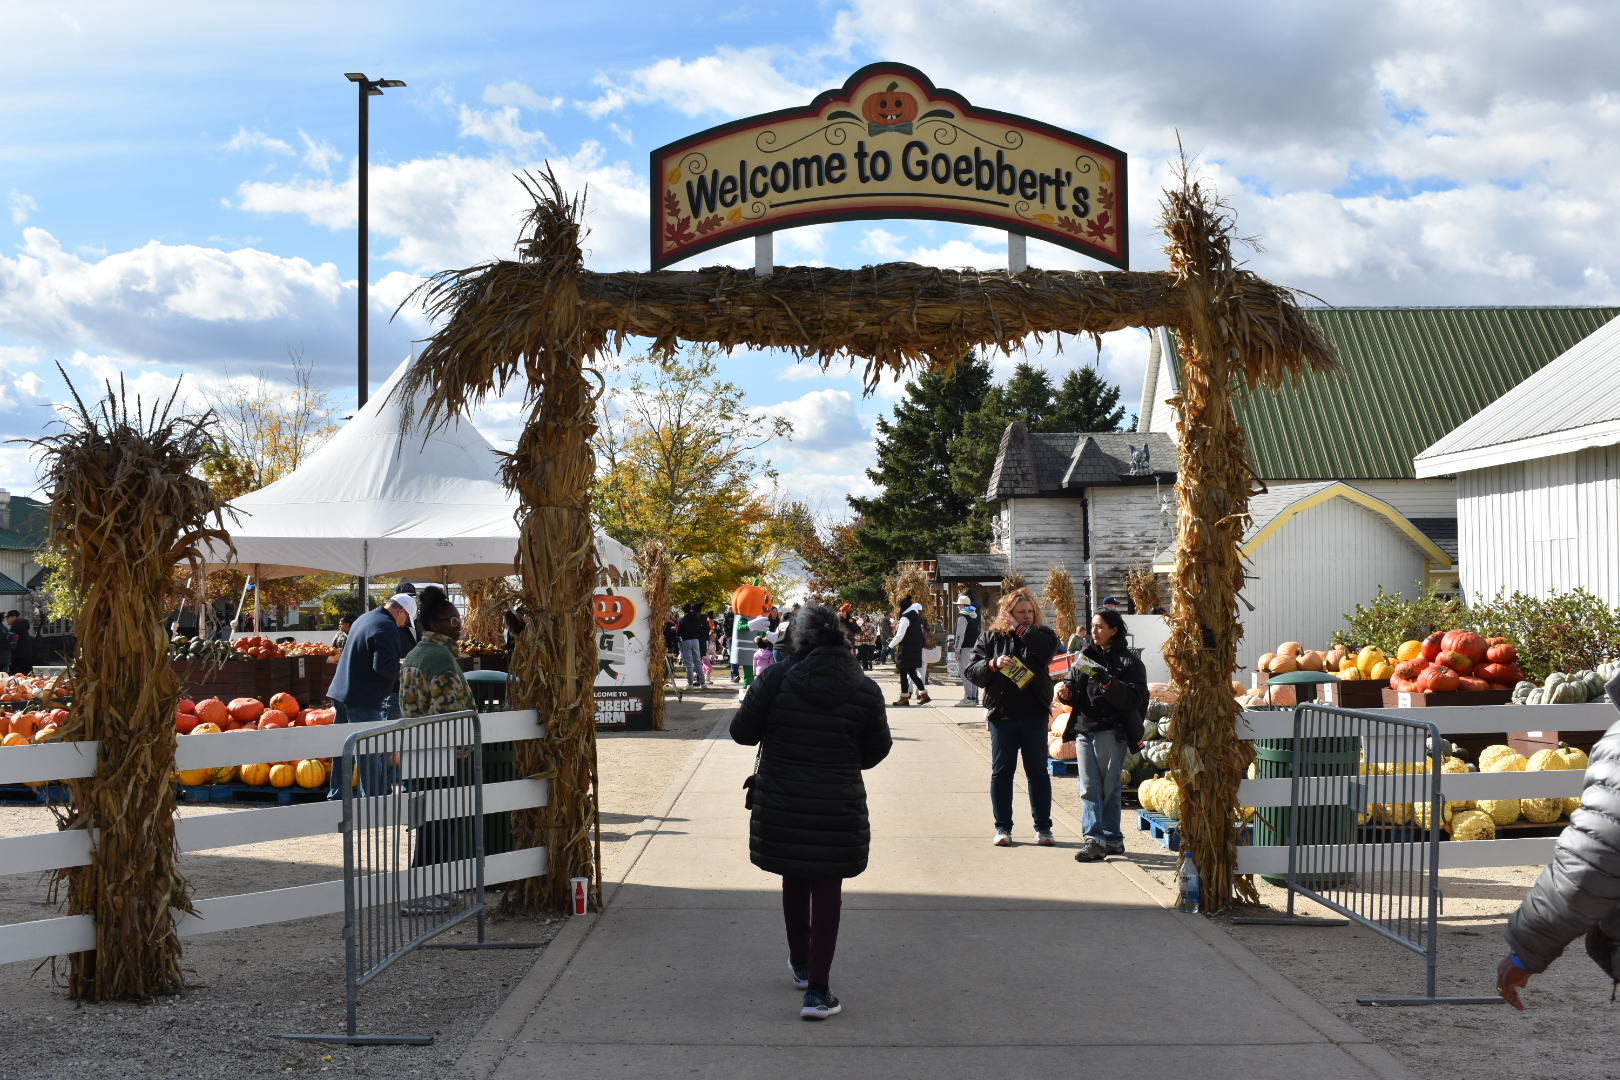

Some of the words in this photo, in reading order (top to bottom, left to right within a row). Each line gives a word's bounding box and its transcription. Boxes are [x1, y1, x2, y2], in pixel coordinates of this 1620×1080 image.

[686, 160, 847, 219] Welcome
[854, 141, 891, 183] to
[902, 140, 1090, 218] Goebbert's
[599, 634, 615, 651] G
[594, 711, 626, 724] ARM
